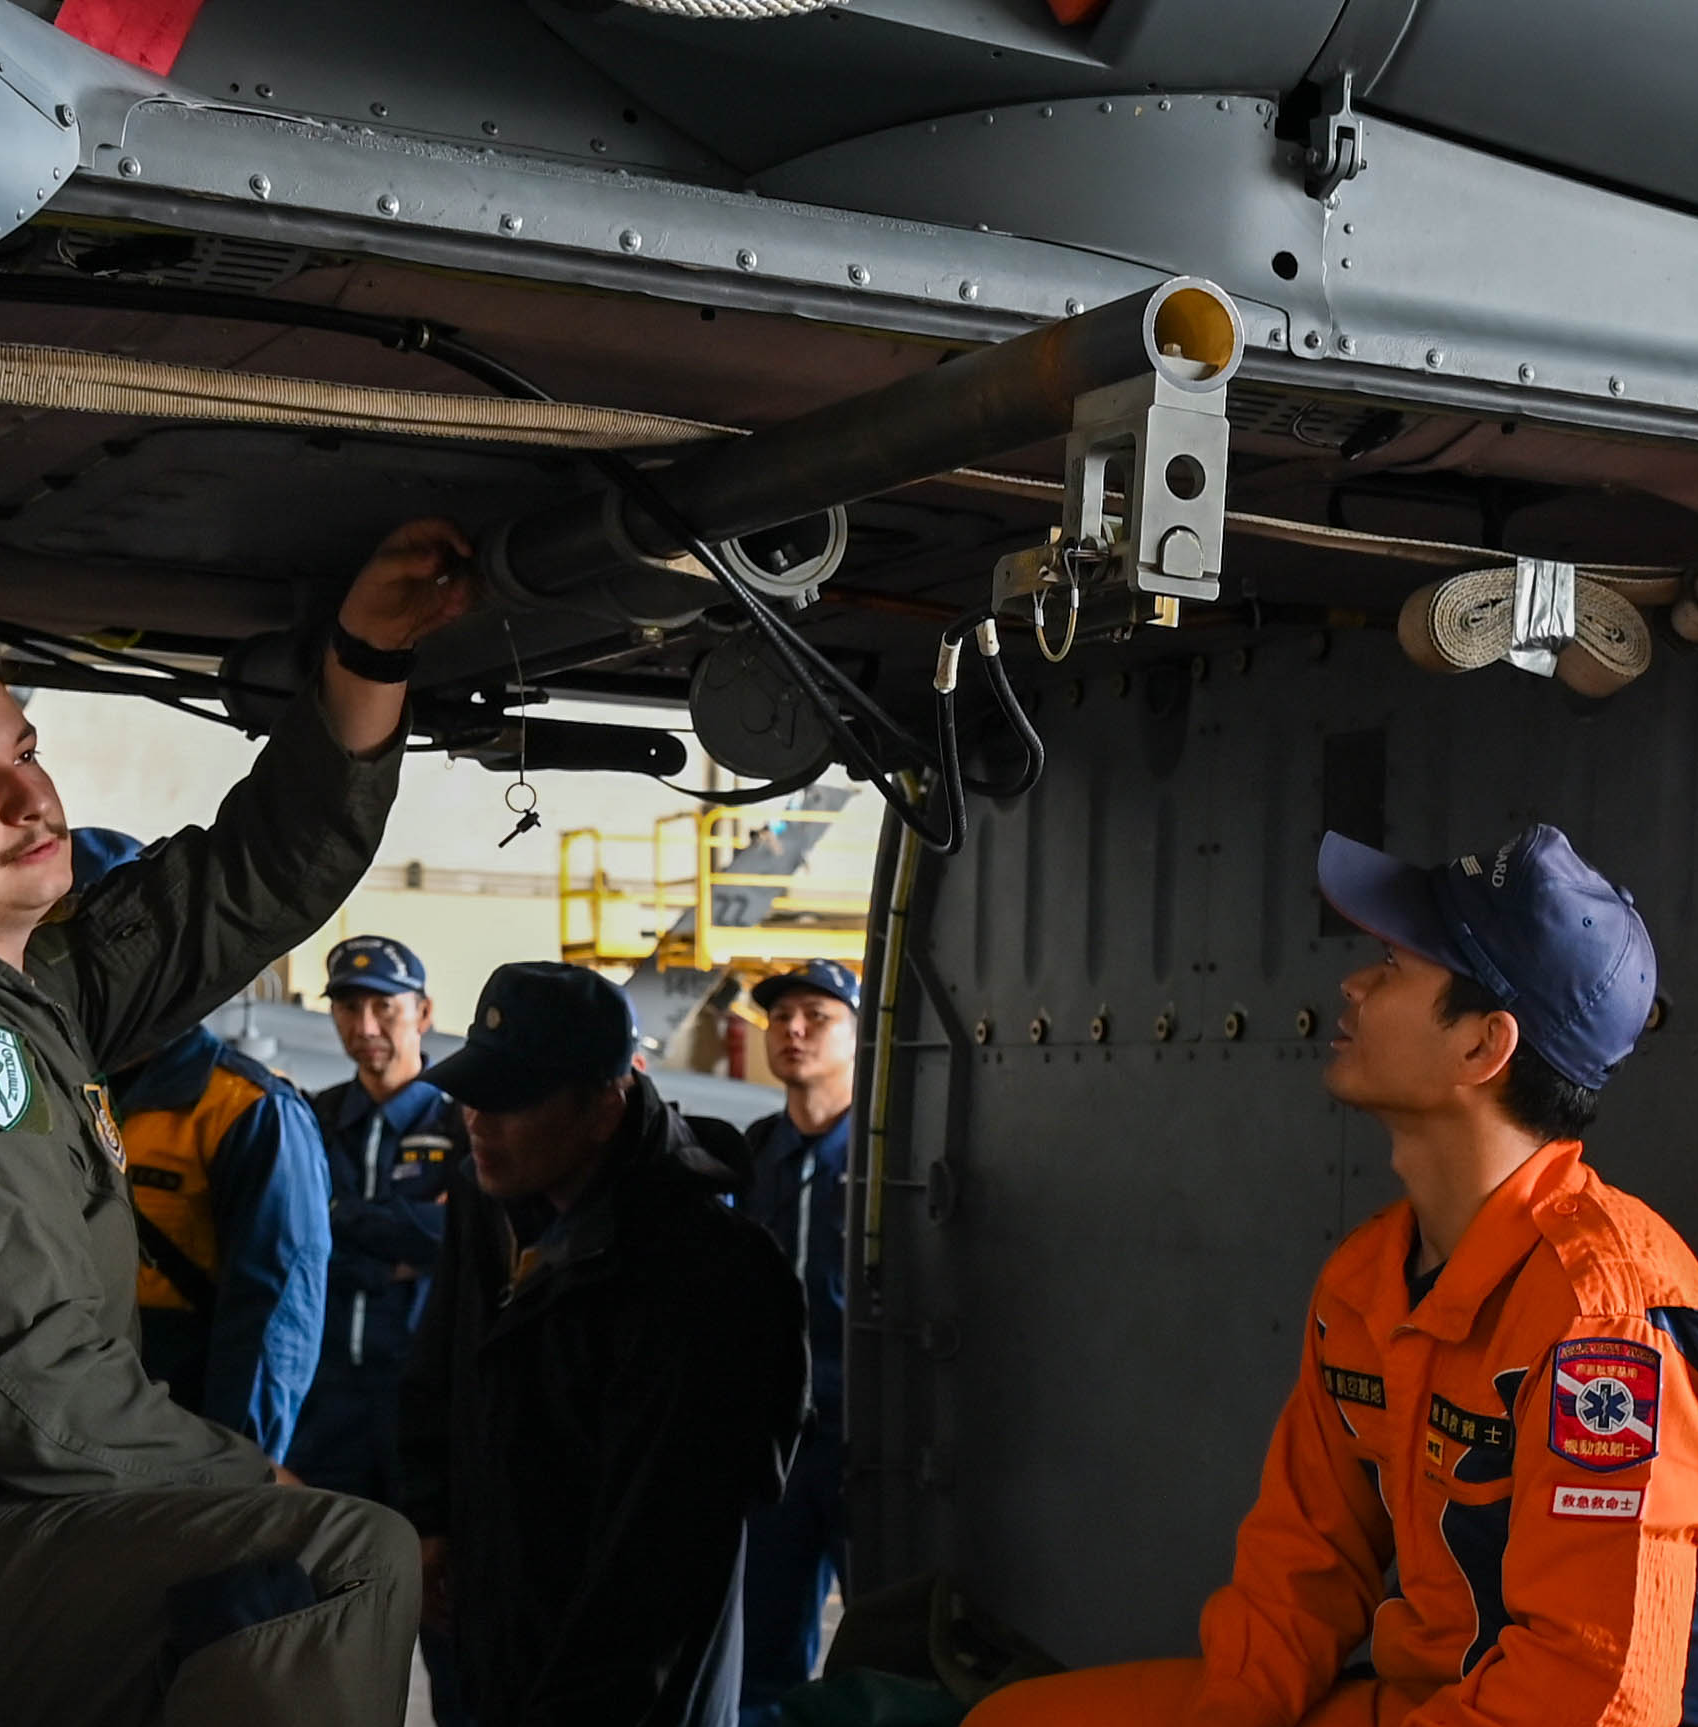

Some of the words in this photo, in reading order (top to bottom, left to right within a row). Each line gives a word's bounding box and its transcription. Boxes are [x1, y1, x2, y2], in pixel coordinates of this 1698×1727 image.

[1561, 1493, 1634, 1511] 救急救命士
